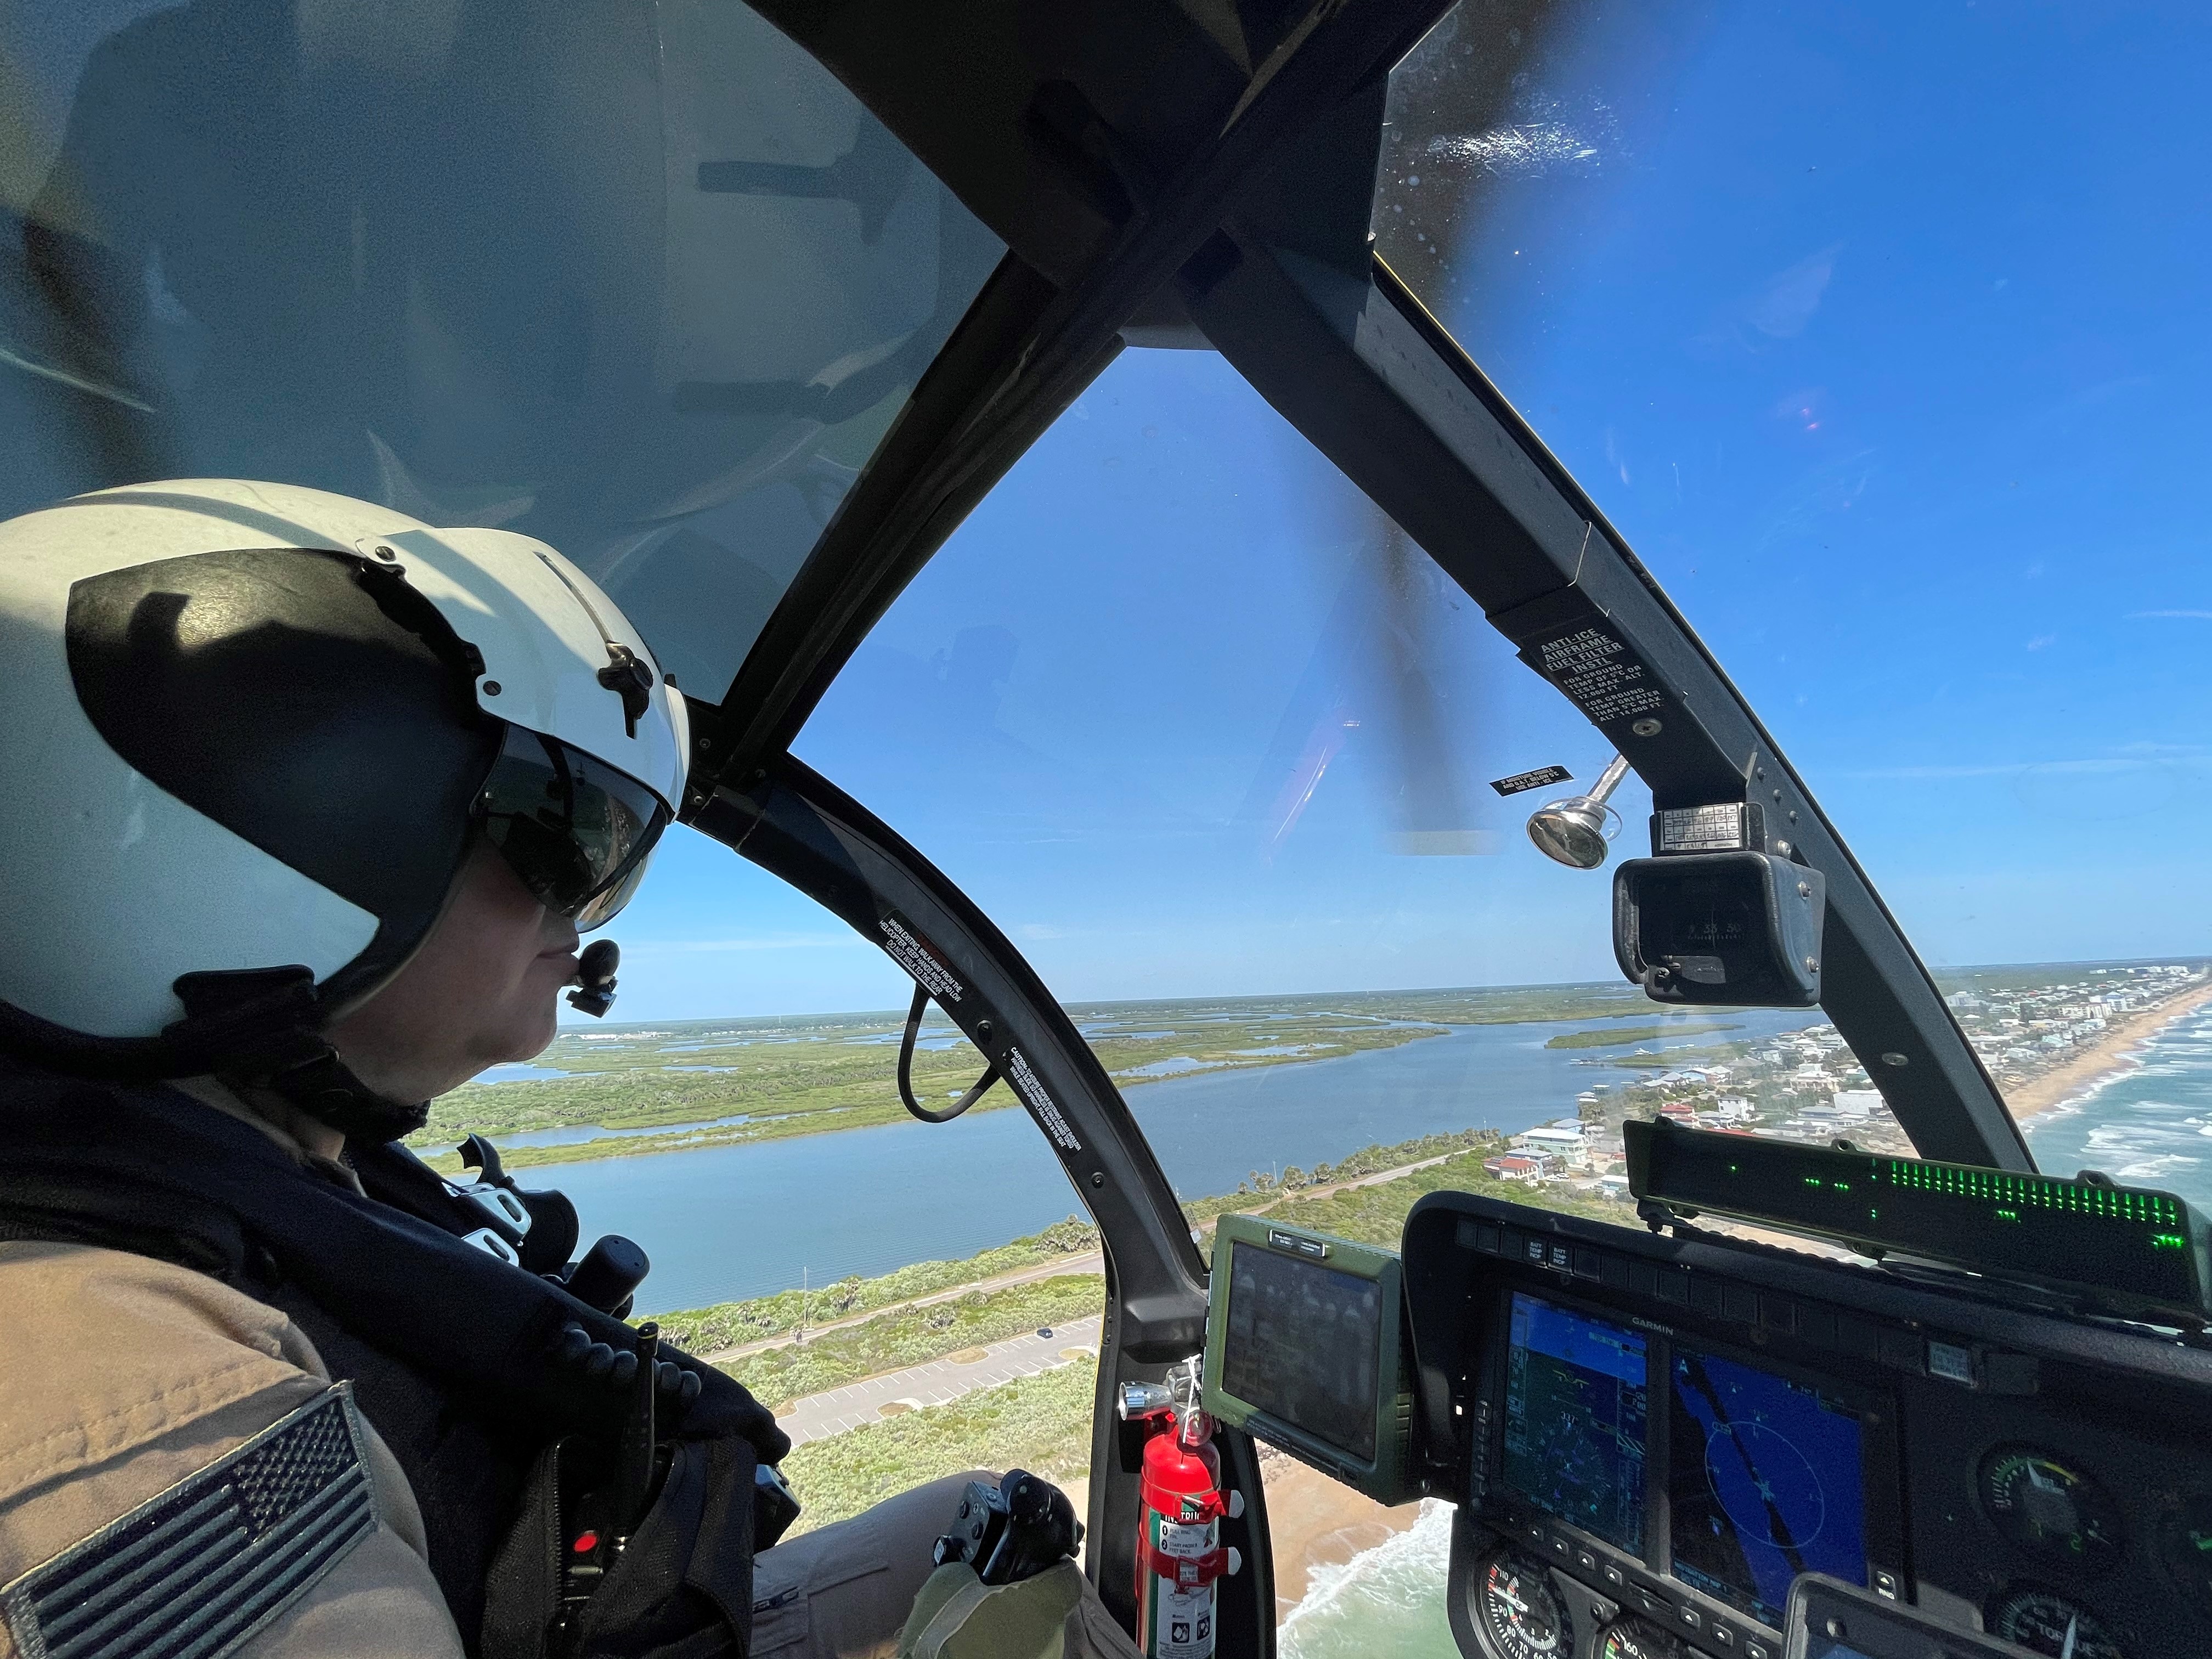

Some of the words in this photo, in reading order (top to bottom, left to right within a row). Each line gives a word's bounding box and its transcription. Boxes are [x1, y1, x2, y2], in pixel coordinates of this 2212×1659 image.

[1541, 628, 1599, 652] ANTI-ICE
[1544, 635, 1611, 662] AIRFRAME
[1546, 656, 1577, 670] FUEL
[1579, 642, 1623, 661] FILTER
[1571, 657, 1611, 673] INSTL
[1564, 677, 1582, 685] FOR
[1583, 664, 1623, 679] GROUND
[1568, 679, 1593, 690] TEMP
[1627, 665, 1642, 673] OR
[1573, 685, 1595, 695] LESS
[1585, 698, 1604, 707] FOR
[1605, 687, 1645, 702] GROUND
[1589, 702, 1615, 712] TEMP
[1617, 690, 1660, 705] GREATER
[1594, 707, 1620, 716] THAN
[888, 918, 904, 934] WHEN
[918, 948, 933, 962] WALK
[929, 960, 944, 972] AWAY
[940, 970, 955, 985] FROM
[952, 981, 963, 993] THE
[887, 939, 896, 949] DO
[894, 946, 906, 957] NOT
[903, 955, 917, 969] WALK
[915, 965, 923, 974] TO
[921, 972, 932, 983] THE
[929, 980, 943, 994] REAR
[905, 946, 919, 958] KEEP
[916, 957, 933, 974] HANDS
[930, 972, 941, 982] AND
[939, 980, 952, 992] HEAD
[950, 990, 962, 1002] LOW
[1632, 1317, 1674, 1336] GARMIN
[1499, 1569, 1508, 1581] 110
[1498, 1605, 1508, 1617] 90
[1506, 1624, 1516, 1637] 80
[1519, 1640, 1528, 1654] 70
[1623, 1639, 1638, 1656] 160
